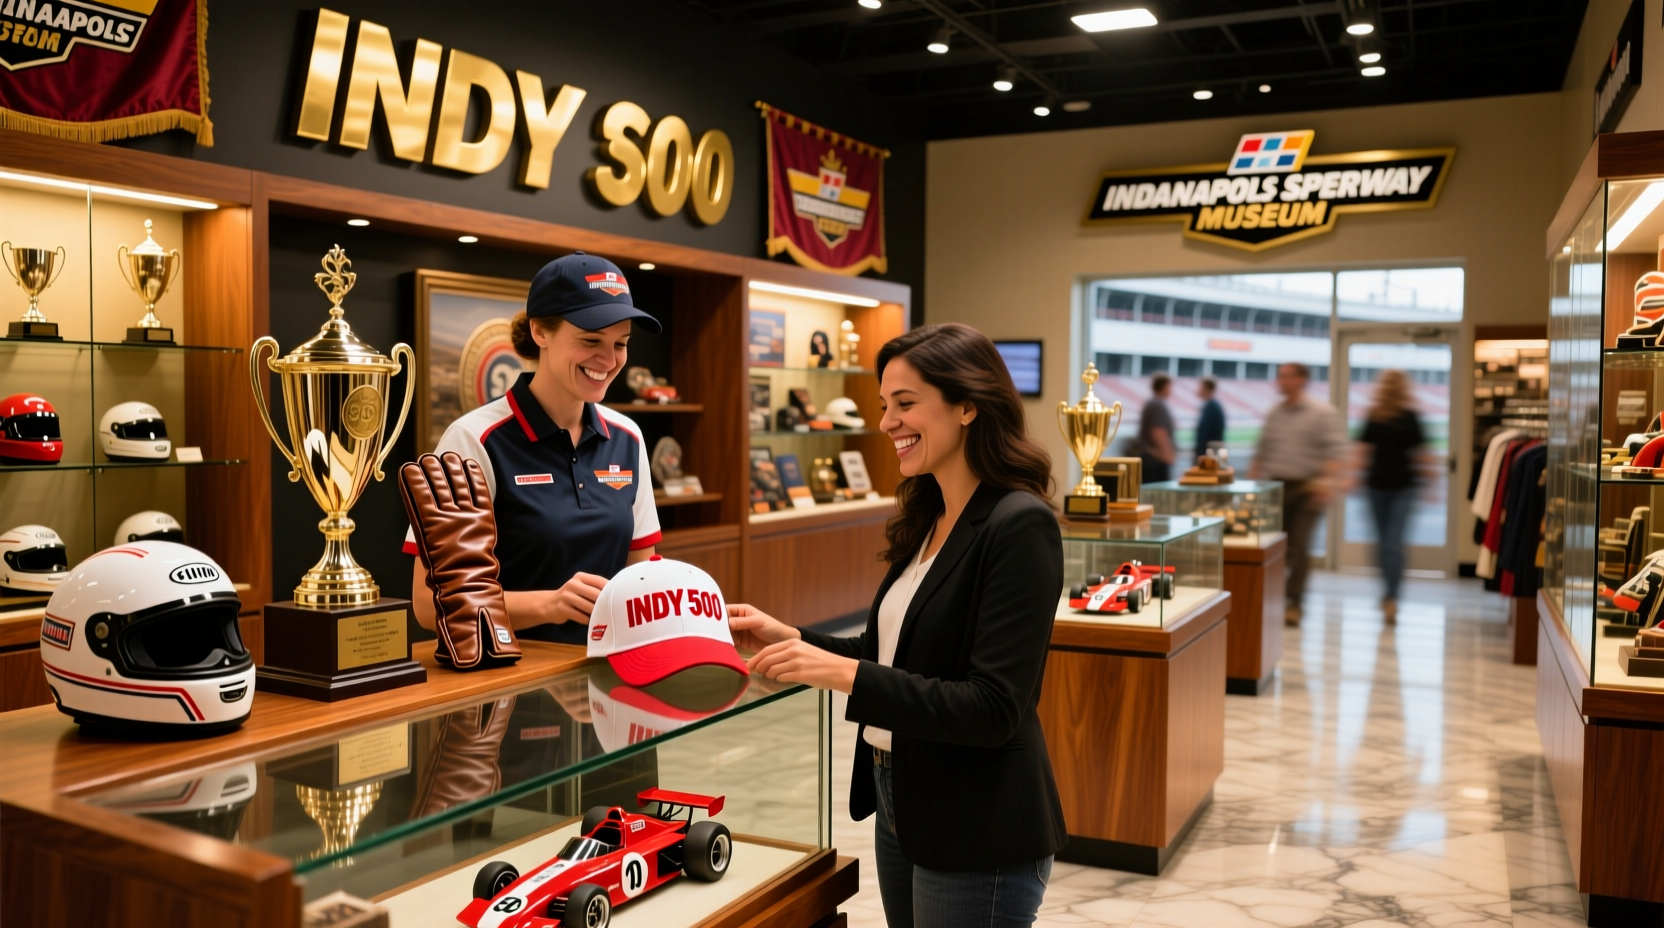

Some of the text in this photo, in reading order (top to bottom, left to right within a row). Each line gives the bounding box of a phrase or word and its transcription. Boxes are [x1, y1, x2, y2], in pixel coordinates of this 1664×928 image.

[297, 8, 588, 189] INDY
[1102, 165, 1433, 212] INDANAPOLS SPERWAY
[1196, 200, 1328, 231] MUSEUM
[626, 588, 723, 628] INDY 500
